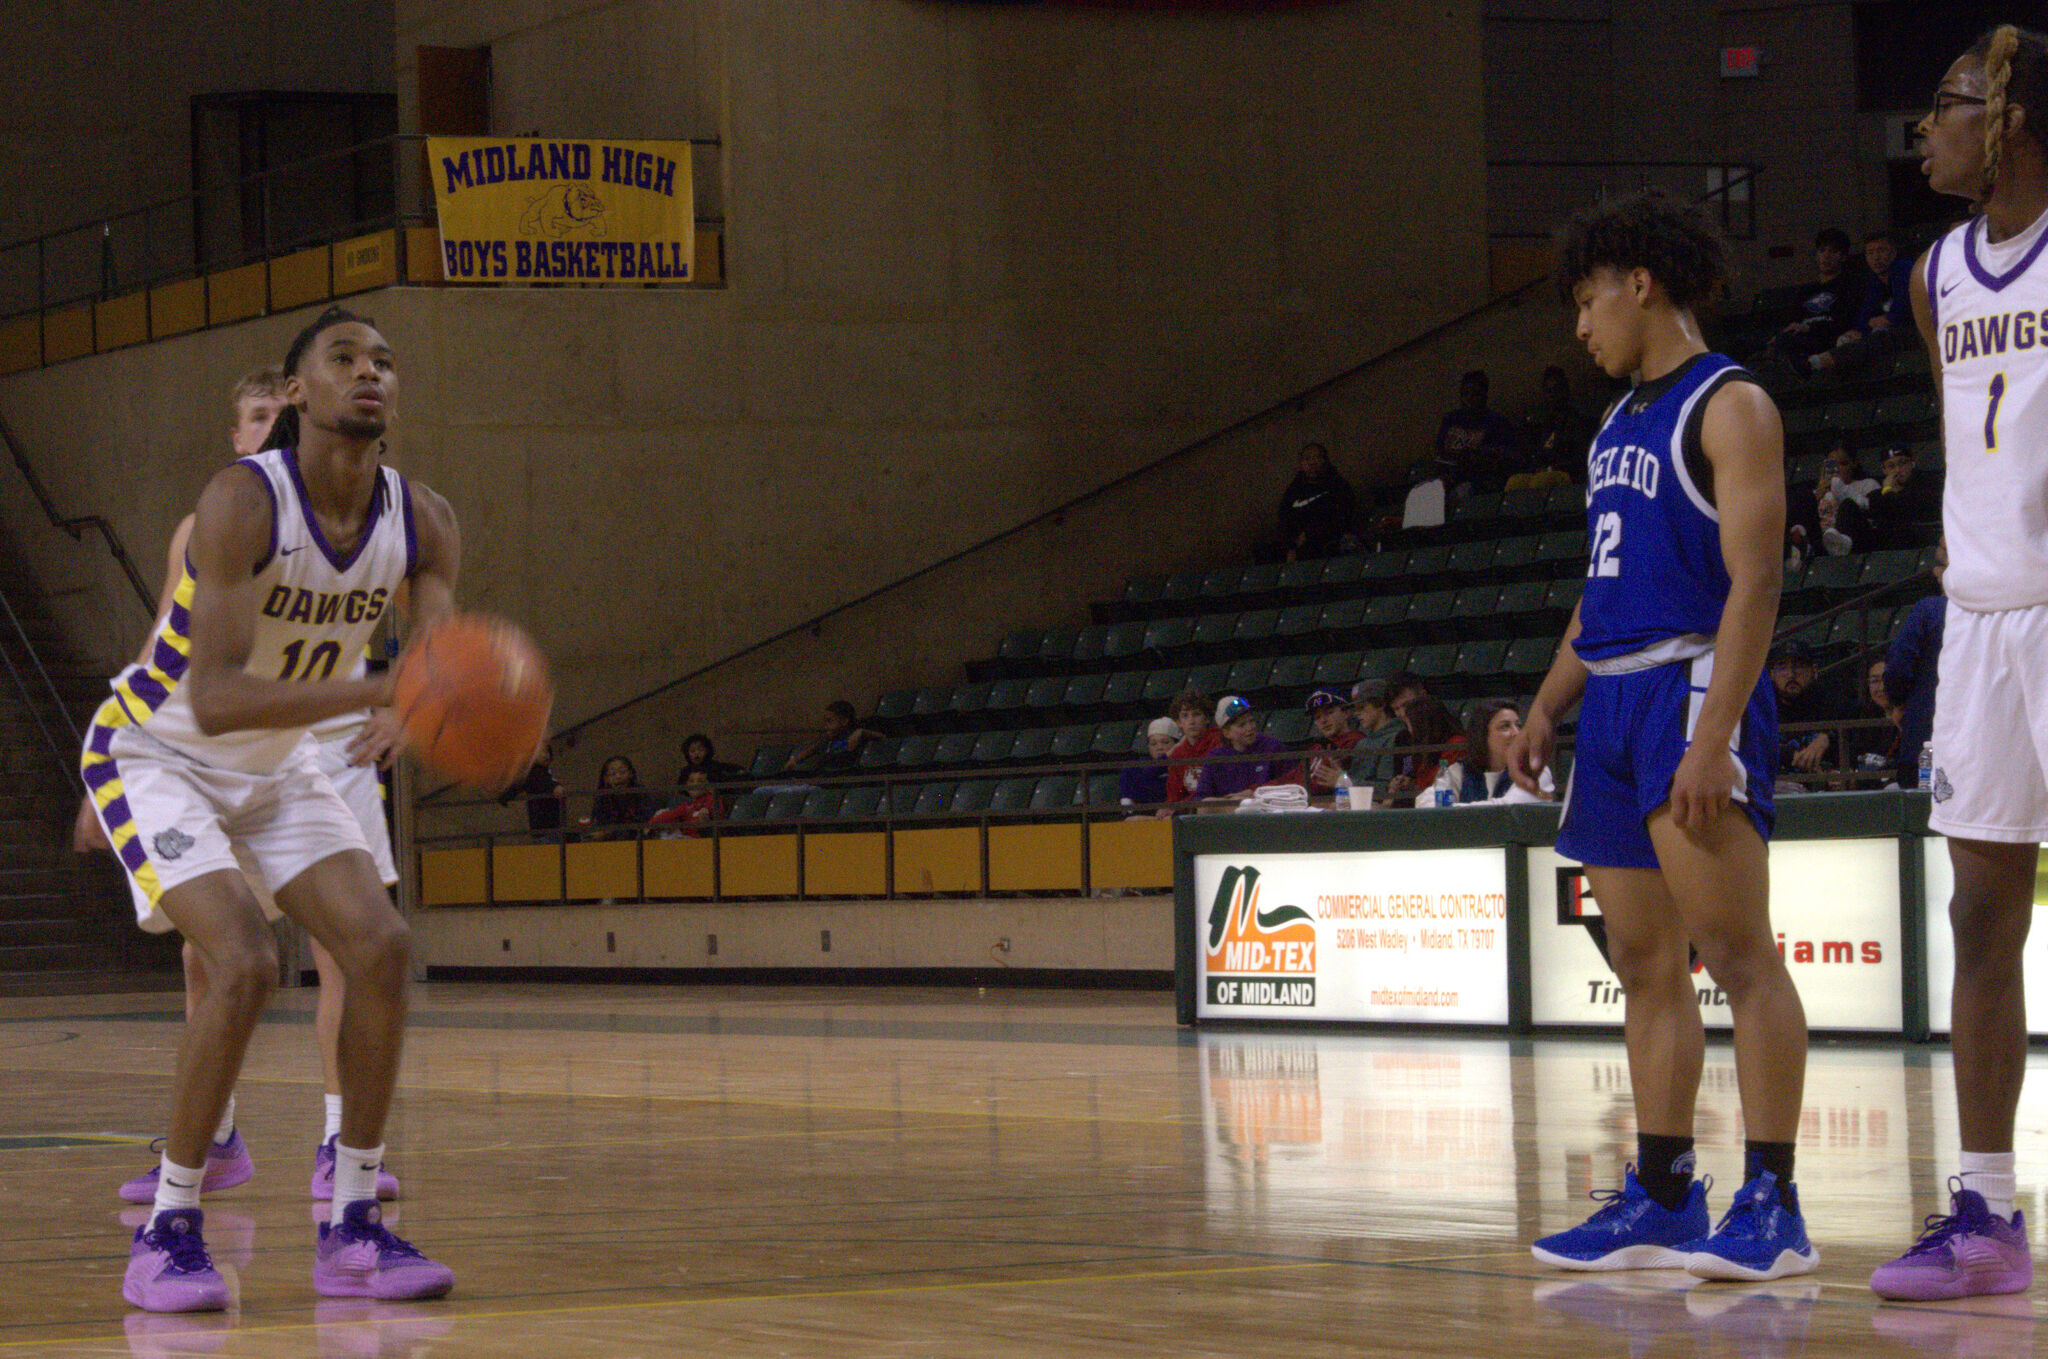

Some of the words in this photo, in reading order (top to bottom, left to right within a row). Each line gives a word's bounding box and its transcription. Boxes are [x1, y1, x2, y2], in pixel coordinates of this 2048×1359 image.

[442, 143, 591, 194] MIDLAND
[602, 146, 676, 197] HIGH
[443, 240, 508, 277] BOYS
[516, 240, 688, 278] BASKETBALL
[1984, 371, 2007, 453] 1
[262, 584, 388, 625] DAWGS
[276, 639, 342, 682] 10
[1317, 894, 1385, 919] COMMERCIAL
[1387, 894, 1437, 919] GENERAL
[1225, 941, 1314, 971] MID-TEX
[1357, 928, 1377, 949] West
[1379, 928, 1408, 954] Wadley
[1457, 928, 1469, 949] TX
[1470, 928, 1495, 949] 79707
[1217, 982, 1238, 1003] OF
[1242, 982, 1313, 1005] MIDLAND
[1370, 984, 1459, 1007] midtexofmidland.com
[1588, 980, 1625, 1004] Tir
